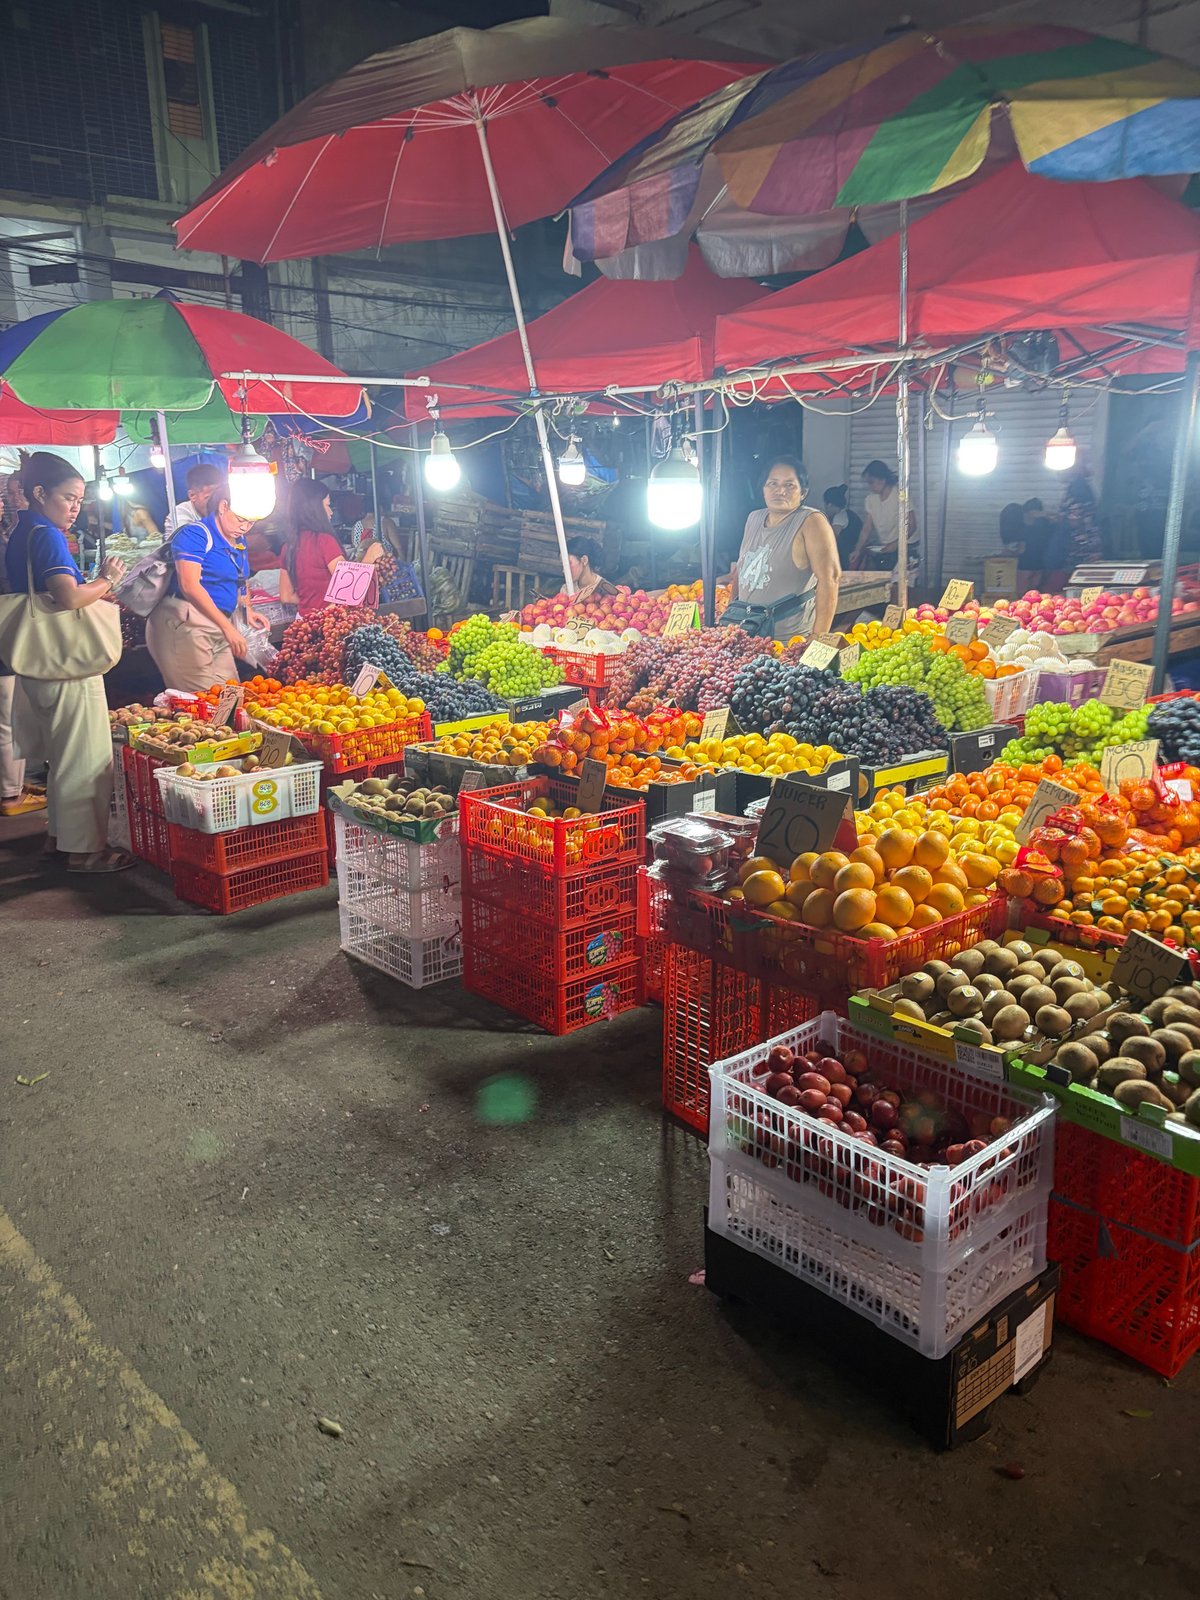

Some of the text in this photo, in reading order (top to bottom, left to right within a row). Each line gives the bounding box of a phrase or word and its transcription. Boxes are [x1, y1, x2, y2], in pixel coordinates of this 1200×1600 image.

[326, 569, 371, 602] 120
[1102, 675, 1145, 702] 150
[259, 744, 280, 767] 20
[1107, 753, 1146, 790] 10
[773, 784, 828, 811] JUICER
[759, 807, 820, 855] 20
[1128, 965, 1172, 997] 100
